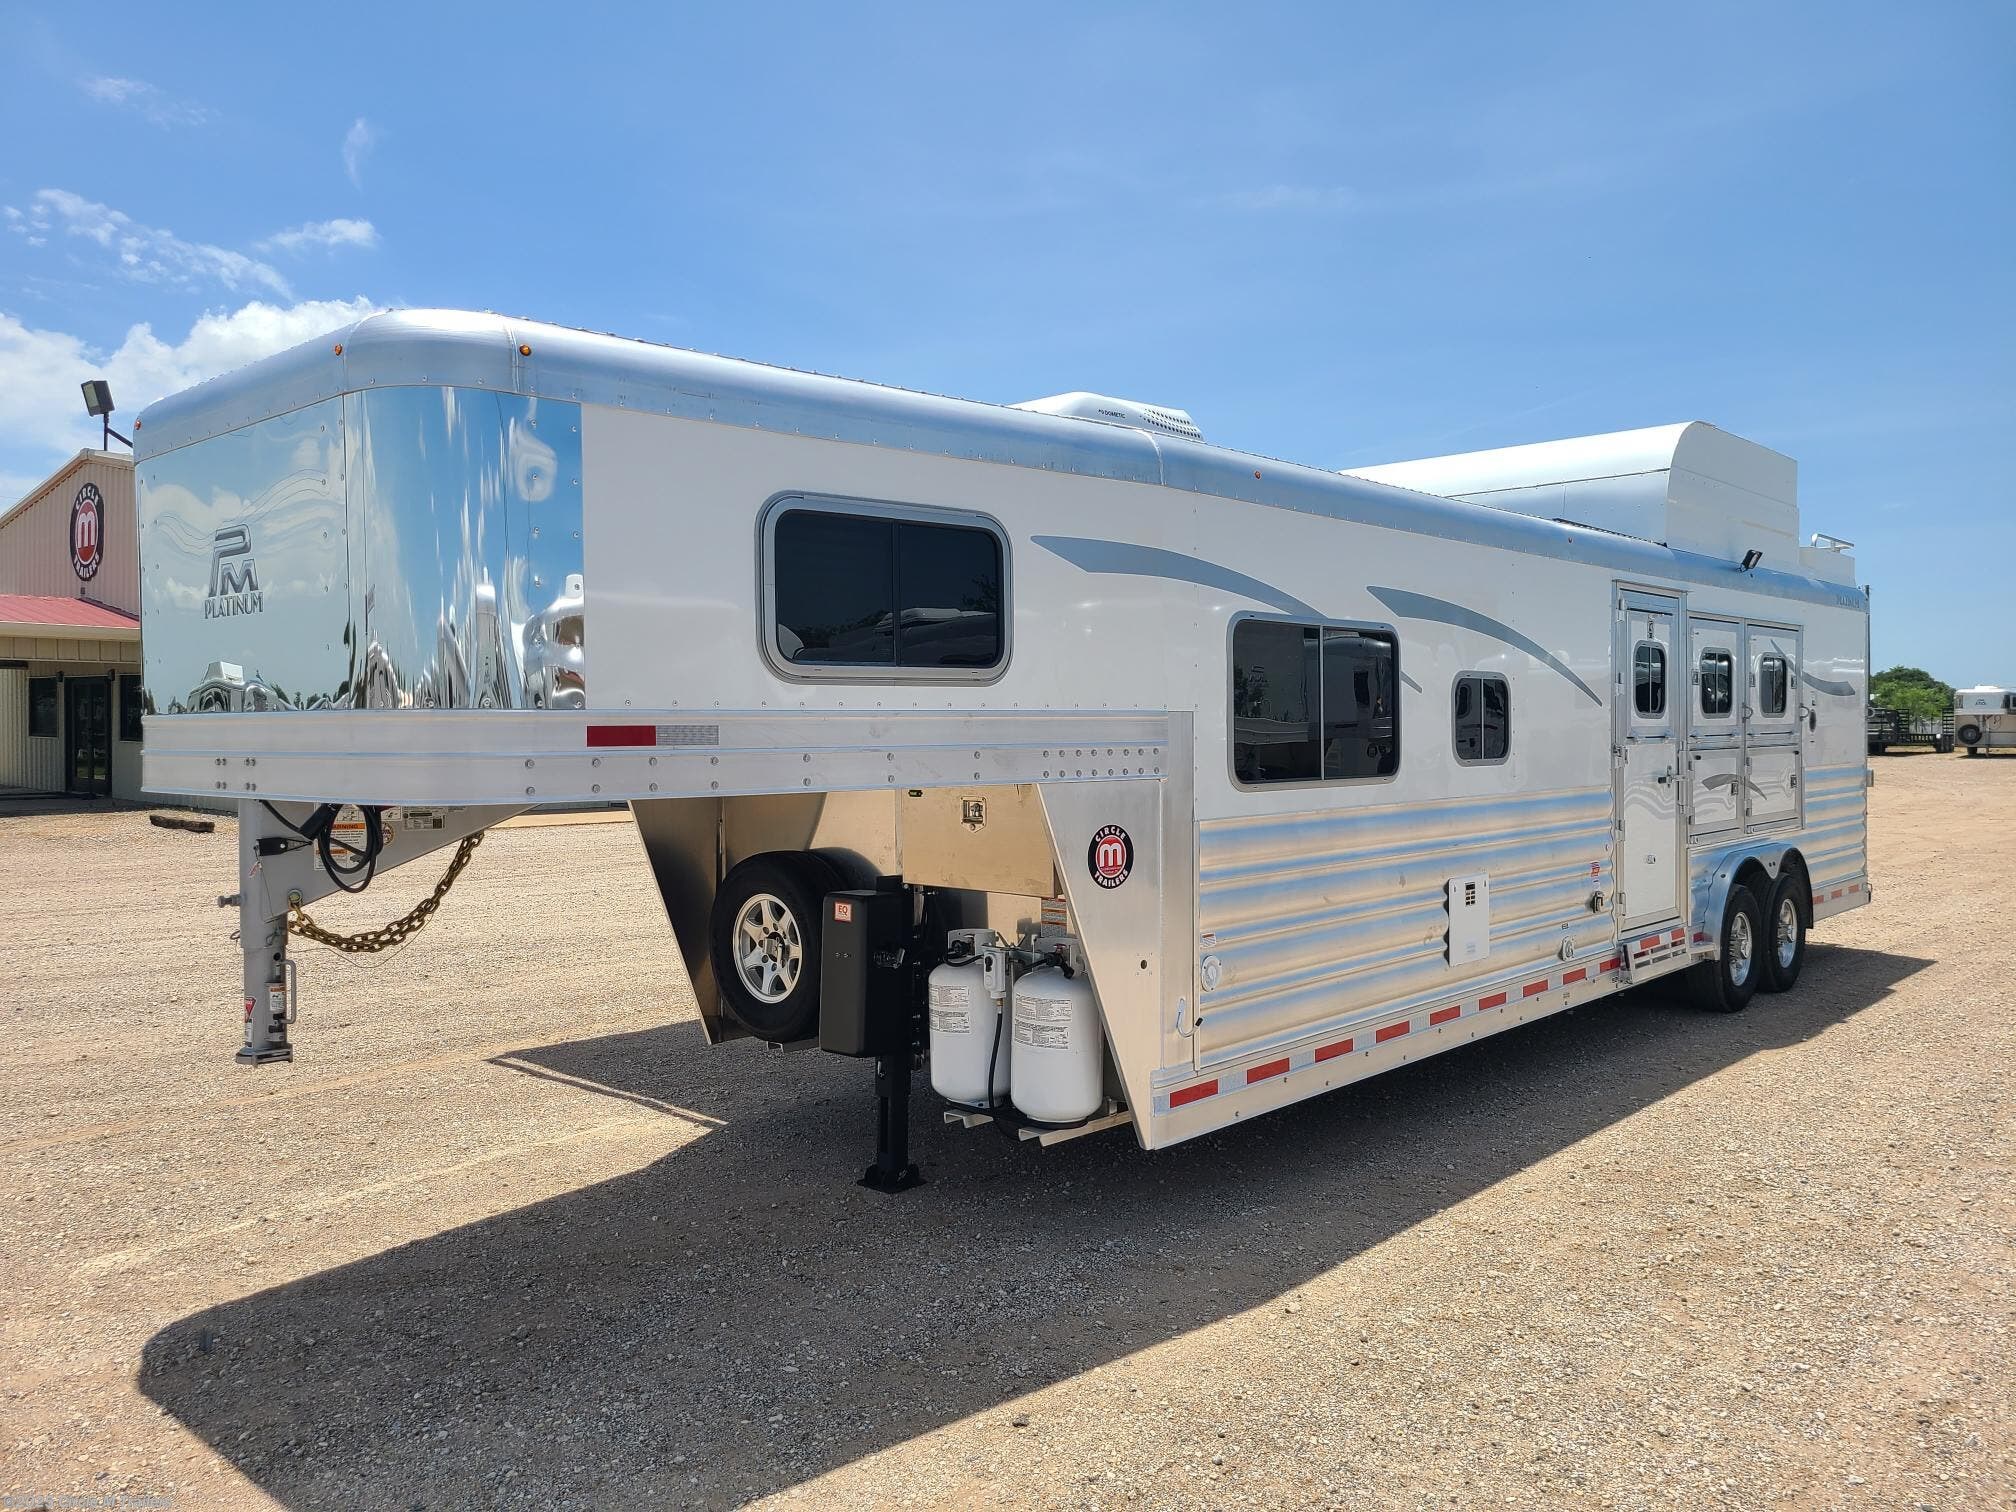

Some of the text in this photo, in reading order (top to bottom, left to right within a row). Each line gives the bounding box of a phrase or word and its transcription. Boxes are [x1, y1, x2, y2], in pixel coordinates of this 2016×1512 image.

[1104, 409, 1126, 419] DOMETIC
[75, 486, 99, 510] CIRCLE
[74, 551, 99, 578] TRAILERS
[205, 592, 263, 619] PLATINUM
[1095, 826, 1126, 841] CIRCLE
[1095, 869, 1128, 887] TRAILERS
[838, 905, 848, 916] EQ
